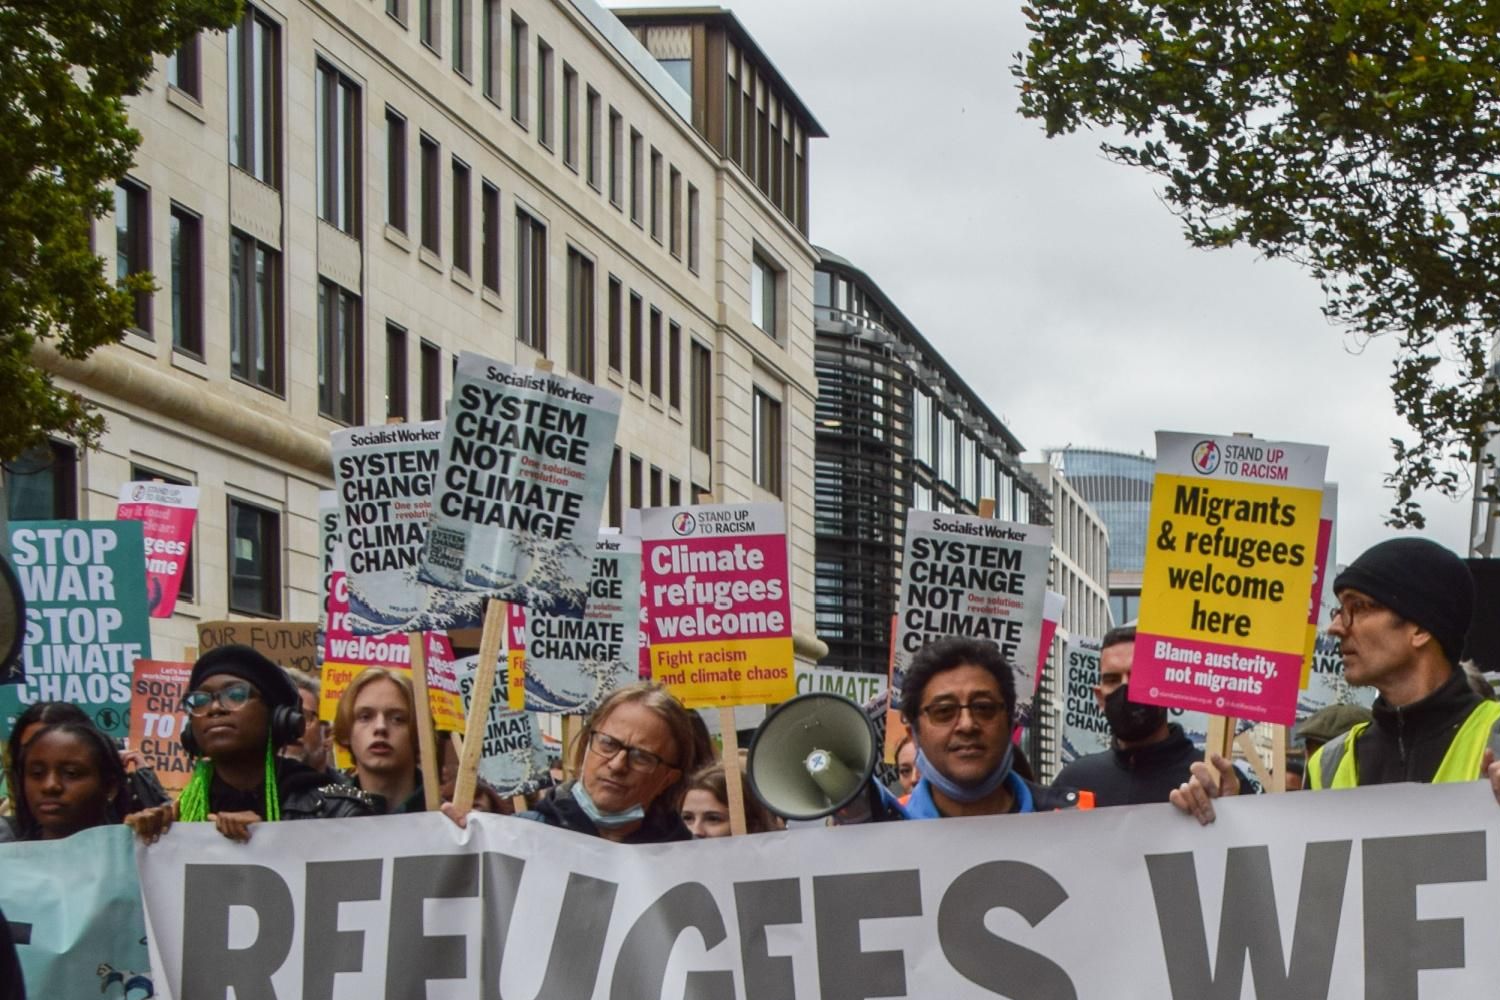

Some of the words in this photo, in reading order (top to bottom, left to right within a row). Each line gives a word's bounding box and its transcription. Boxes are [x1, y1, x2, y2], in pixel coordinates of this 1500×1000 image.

[486, 365, 546, 393] Socialist
[546, 379, 595, 405] Worker
[458, 383, 588, 438] SYSTEM
[351, 431, 397, 447] Socialist
[398, 429, 441, 443] Worker
[455, 411, 590, 467] CHANGE
[1224, 444, 1264, 462] STAND
[1266, 448, 1284, 463] UP
[339, 449, 440, 480] SYSTEM
[450, 436, 517, 475] NOT
[1224, 461, 1238, 476] TO
[1240, 462, 1289, 481] RACISM
[343, 473, 437, 503] CHANG
[445, 464, 584, 519] CLIMATE
[519, 468, 569, 487] revolution
[345, 501, 392, 527] NOT
[440, 491, 577, 541] CHANGE
[698, 511, 732, 523] STAND
[734, 510, 749, 521] UP
[1174, 484, 1297, 527] Migrants
[348, 522, 430, 550] CLIMA
[699, 523, 713, 534] TO
[715, 521, 756, 533] RACISM
[933, 518, 984, 537] Socialist
[984, 525, 1028, 542] Worker
[11, 528, 119, 566] STOP
[651, 543, 765, 575] Climate
[911, 537, 1023, 571] SYSTEM
[1156, 520, 1177, 551] &
[1184, 526, 1306, 568] refugees
[17, 565, 116, 602] WAR
[653, 575, 784, 610] refugees
[909, 561, 1026, 596] CHANGE
[1168, 563, 1285, 603] welcome
[907, 584, 965, 612] NOT
[25, 607, 124, 645] STOP
[530, 618, 625, 643] CLIMATE
[655, 607, 785, 638] welcome
[905, 608, 1023, 643] CLIMATE
[1190, 599, 1252, 638] here
[200, 626, 239, 648] OUR
[250, 626, 320, 650] FUTURE
[330, 636, 411, 664] welcom
[530, 639, 622, 662] CHANGE
[24, 643, 142, 675] LIMATE
[657, 650, 693, 668] Fight
[698, 647, 747, 663] racism
[1154, 640, 1203, 664] Blame
[1204, 653, 1279, 680] austerity,
[17, 673, 133, 705] CHAOS
[326, 669, 353, 686] Fight
[659, 670, 685, 685] and
[690, 668, 742, 684] climate
[747, 665, 788, 681] chaos
[796, 672, 880, 705] CLIMATE
[1164, 666, 1192, 685] not
[1194, 669, 1263, 695] migrants
[1067, 682, 1095, 700] NOT
[143, 712, 175, 738] TO
